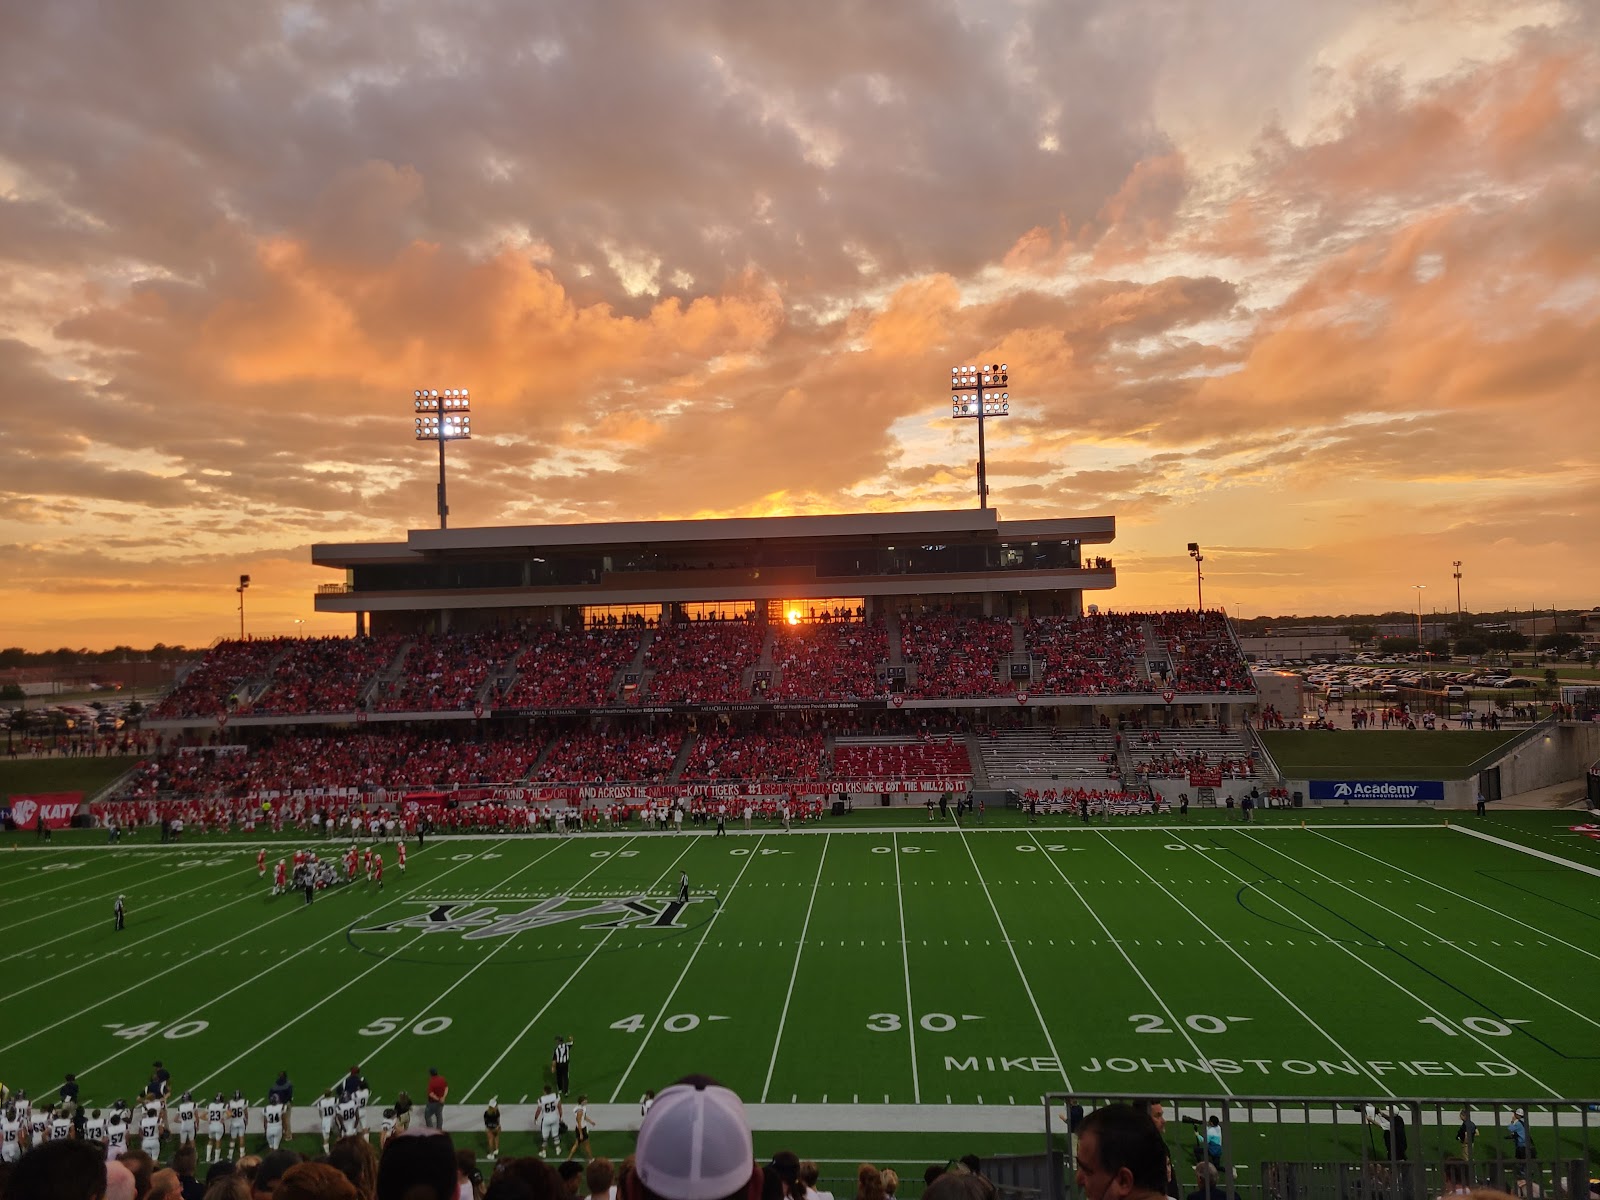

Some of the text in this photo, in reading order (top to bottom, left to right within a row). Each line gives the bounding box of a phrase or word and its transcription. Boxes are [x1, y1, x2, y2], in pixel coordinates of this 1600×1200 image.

[579, 786, 597, 798] AND
[598, 786, 632, 798] ACROSS
[633, 786, 648, 798] THE
[687, 784, 709, 797] KATY
[710, 784, 739, 796] TIGERS
[747, 783, 763, 795] #1
[845, 781, 862, 793] KHS
[885, 780, 901, 792] GOT
[902, 780, 918, 792] THE
[919, 780, 938, 792] WILL
[1353, 782, 1418, 797] Academy
[40, 803, 79, 820] KATY
[112, 1020, 210, 1041] 40
[358, 1016, 454, 1036] 50
[608, 1013, 701, 1033] 40
[865, 1013, 958, 1033] 30
[1127, 1013, 1228, 1034] 20
[1416, 1016, 1513, 1037] 10
[943, 1055, 1518, 1077] MIKE JOHNSTON FIELD
[210, 1110, 221, 1121] 23
[4, 1130, 16, 1142] 15
[54, 1125, 67, 1138] 55
[111, 1132, 124, 1144] 57
